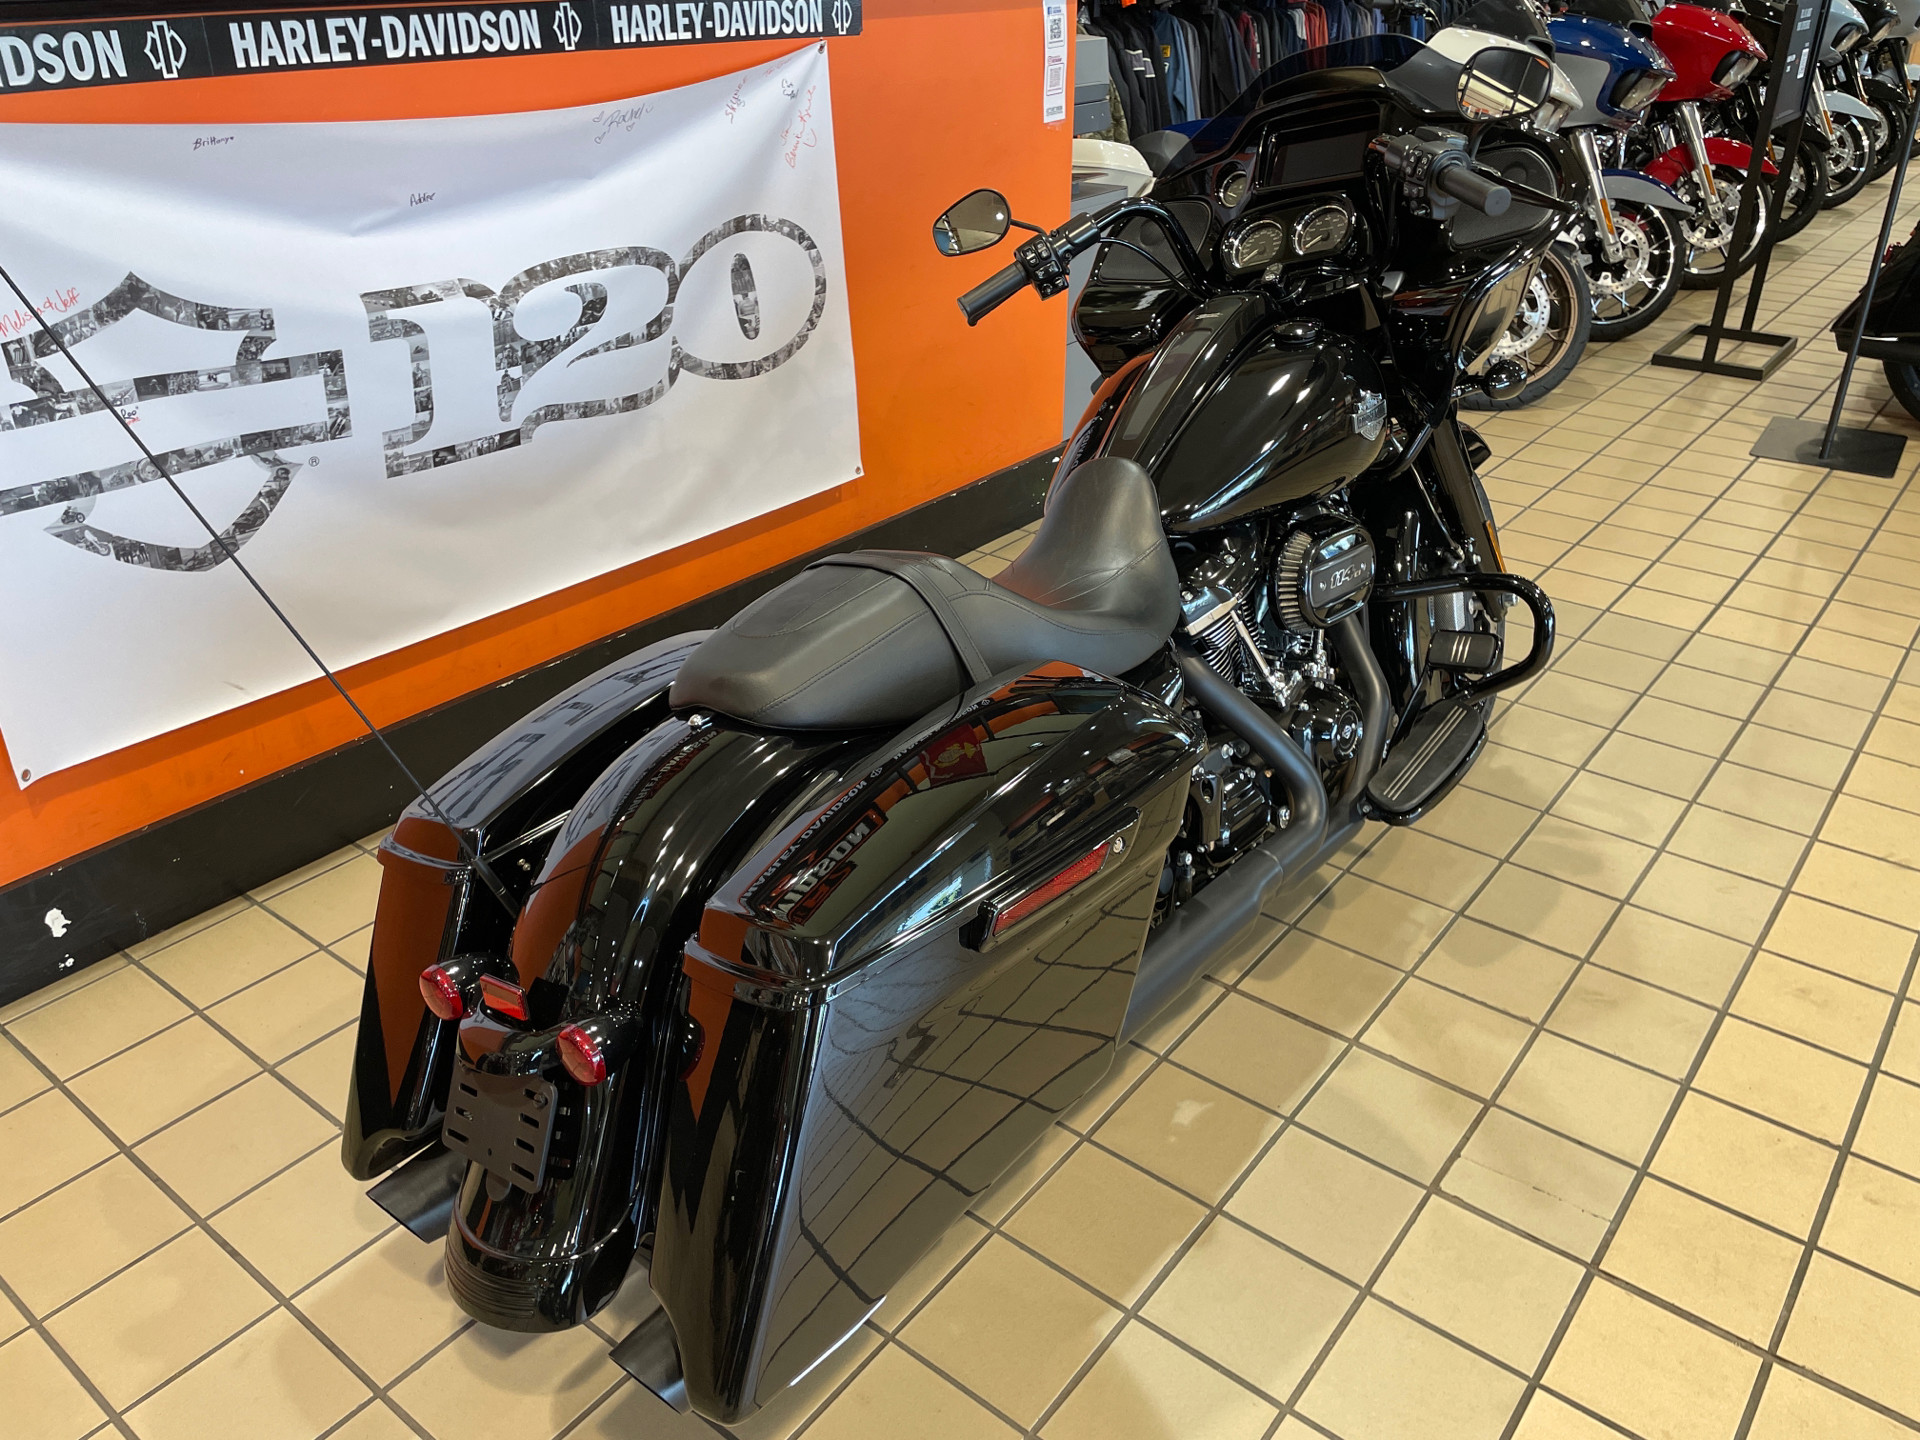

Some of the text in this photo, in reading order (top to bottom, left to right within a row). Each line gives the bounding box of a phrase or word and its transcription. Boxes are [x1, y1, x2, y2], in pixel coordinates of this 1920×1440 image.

[228, 9, 542, 69] HARLEY-DAVIDSON
[610, 0, 823, 44] HARLEY-DAVIDSON
[0, 29, 128, 88] DSON
[359, 214, 827, 479] 120
[1330, 563, 1355, 589] 114
